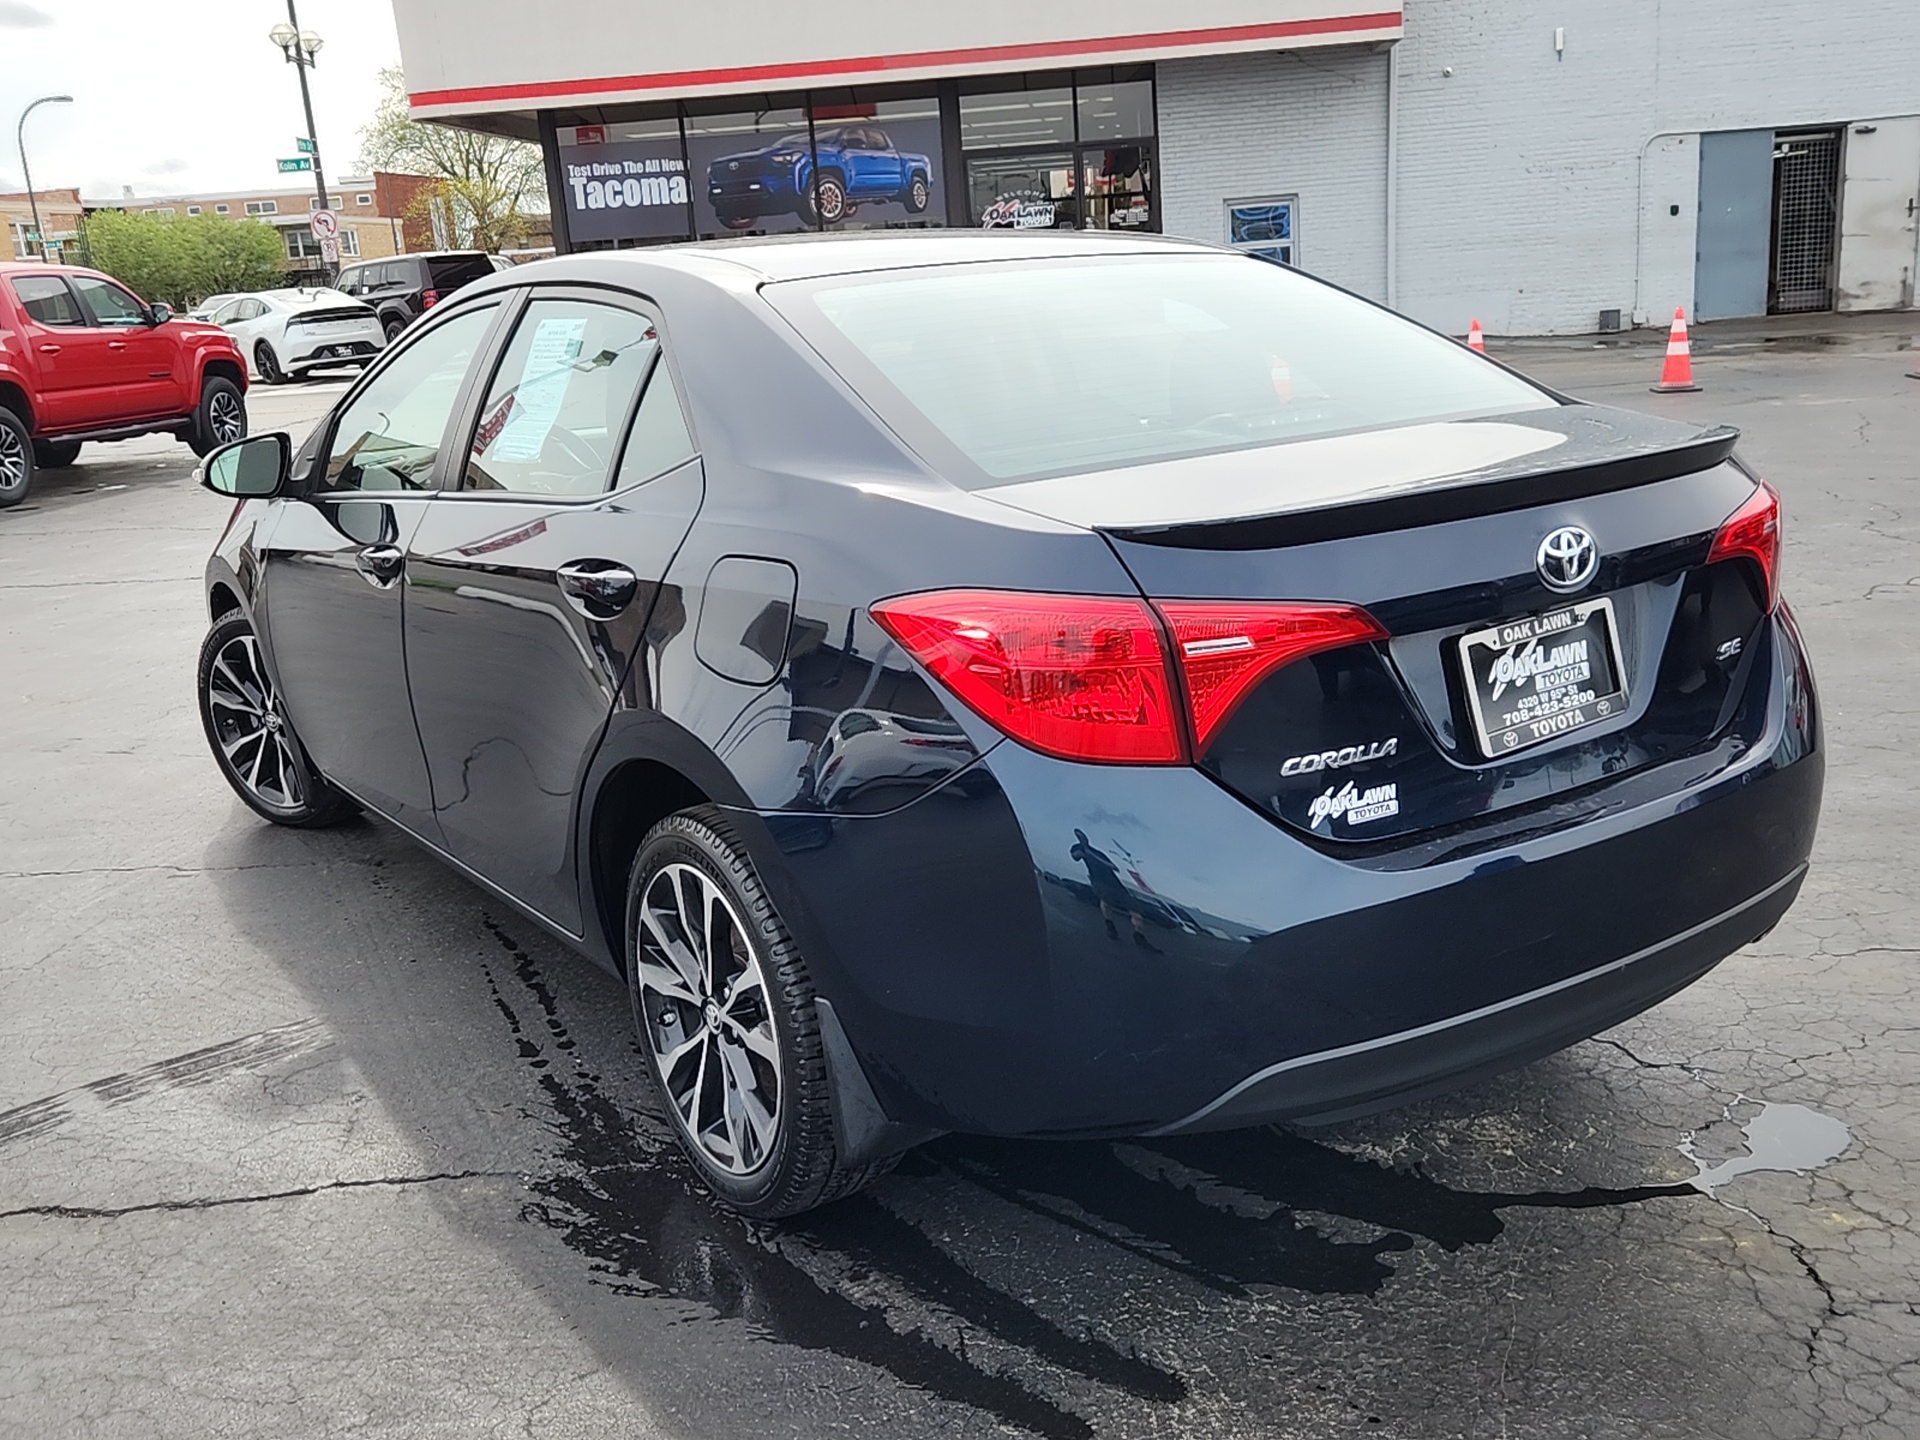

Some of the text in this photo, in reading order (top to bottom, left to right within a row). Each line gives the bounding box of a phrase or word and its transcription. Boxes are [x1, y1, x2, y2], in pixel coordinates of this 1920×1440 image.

[567, 164, 592, 177] Test
[592, 162, 622, 176] Drive
[622, 160, 644, 174] The
[645, 159, 660, 173] All
[568, 176, 695, 210] Tacoma
[1503, 612, 1572, 643] OAK LAWN
[1716, 637, 1742, 660] SE
[1541, 665, 1586, 687] TOYOTA
[1502, 689, 1596, 726] 708-423-5200
[1517, 695, 1539, 709] 4320
[1540, 691, 1549, 703] W
[1530, 708, 1585, 738] TOYOTA
[1281, 737, 1398, 777] COROLLA
[1354, 803, 1392, 819] TOYOTA
